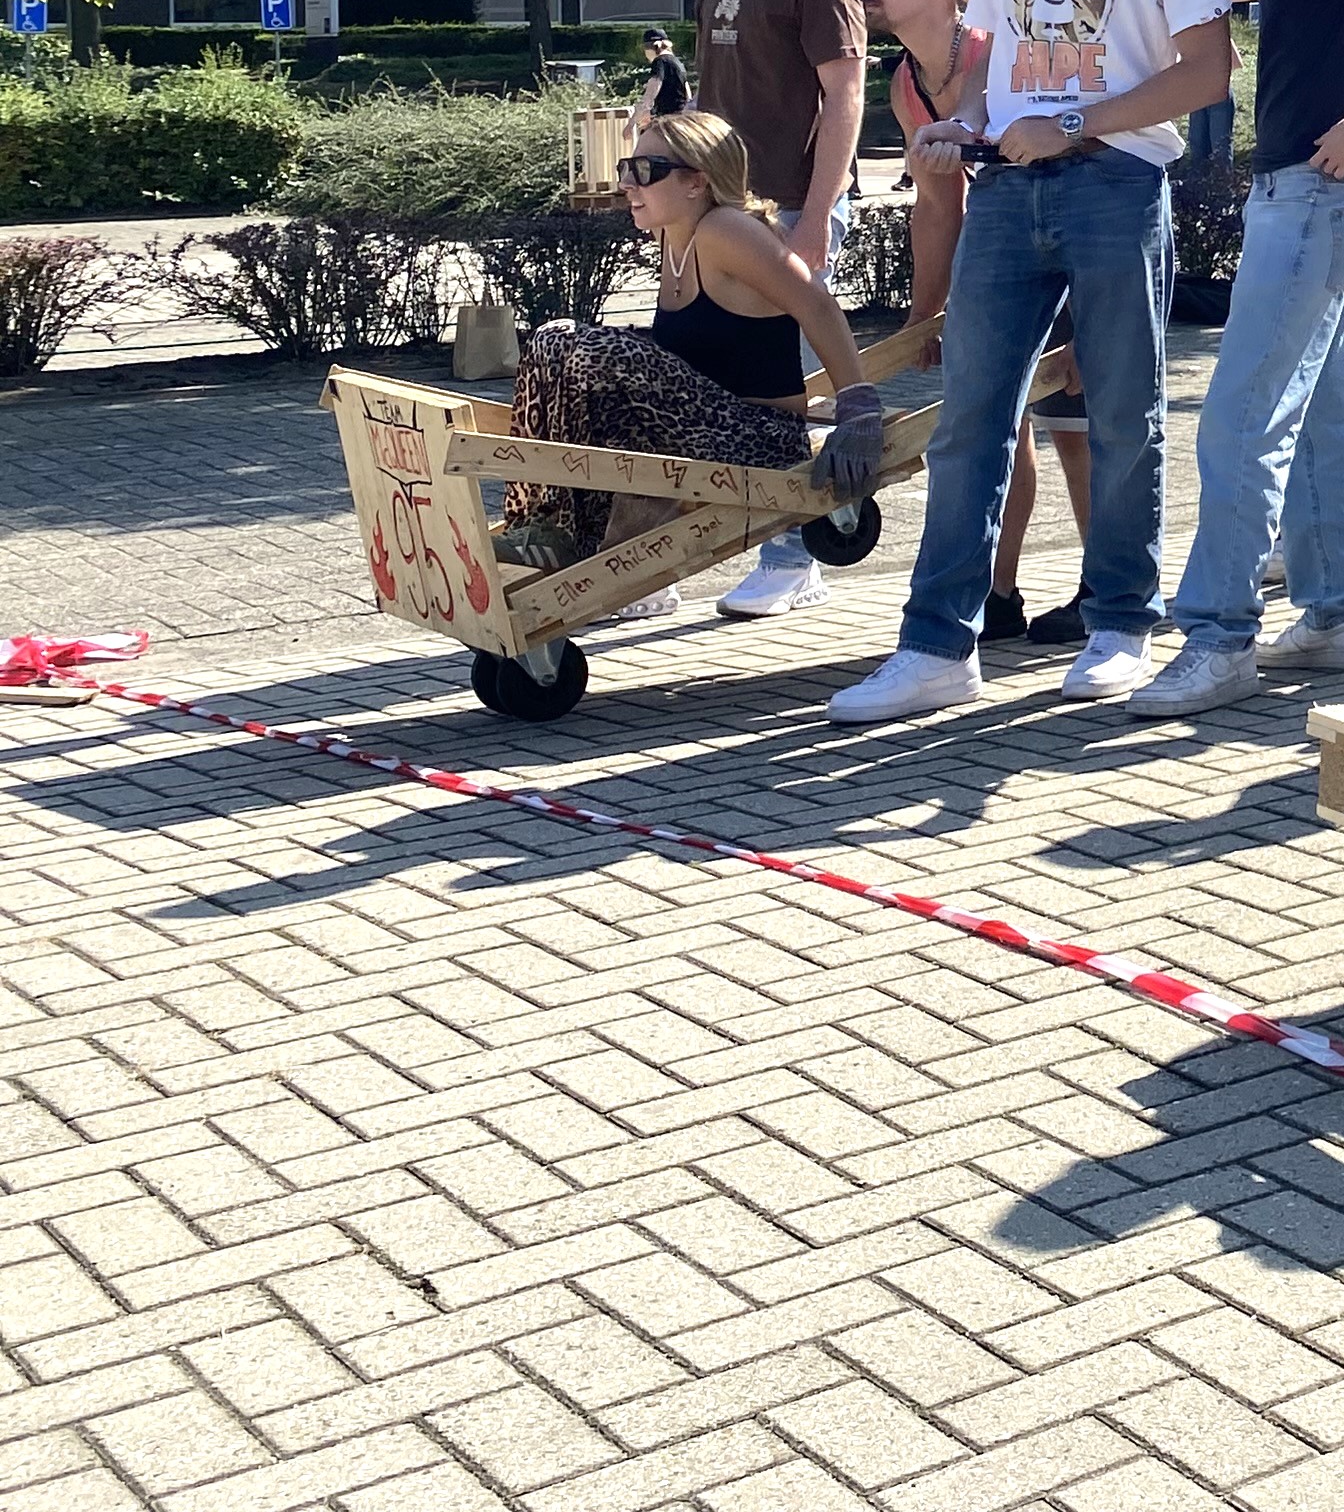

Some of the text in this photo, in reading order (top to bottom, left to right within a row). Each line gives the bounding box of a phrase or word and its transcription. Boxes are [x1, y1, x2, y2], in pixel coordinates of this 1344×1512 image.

[377, 400, 404, 424] TEAM
[392, 489, 454, 622] 95
[553, 577, 595, 607] Ellen
[688, 515, 723, 538] Joel
